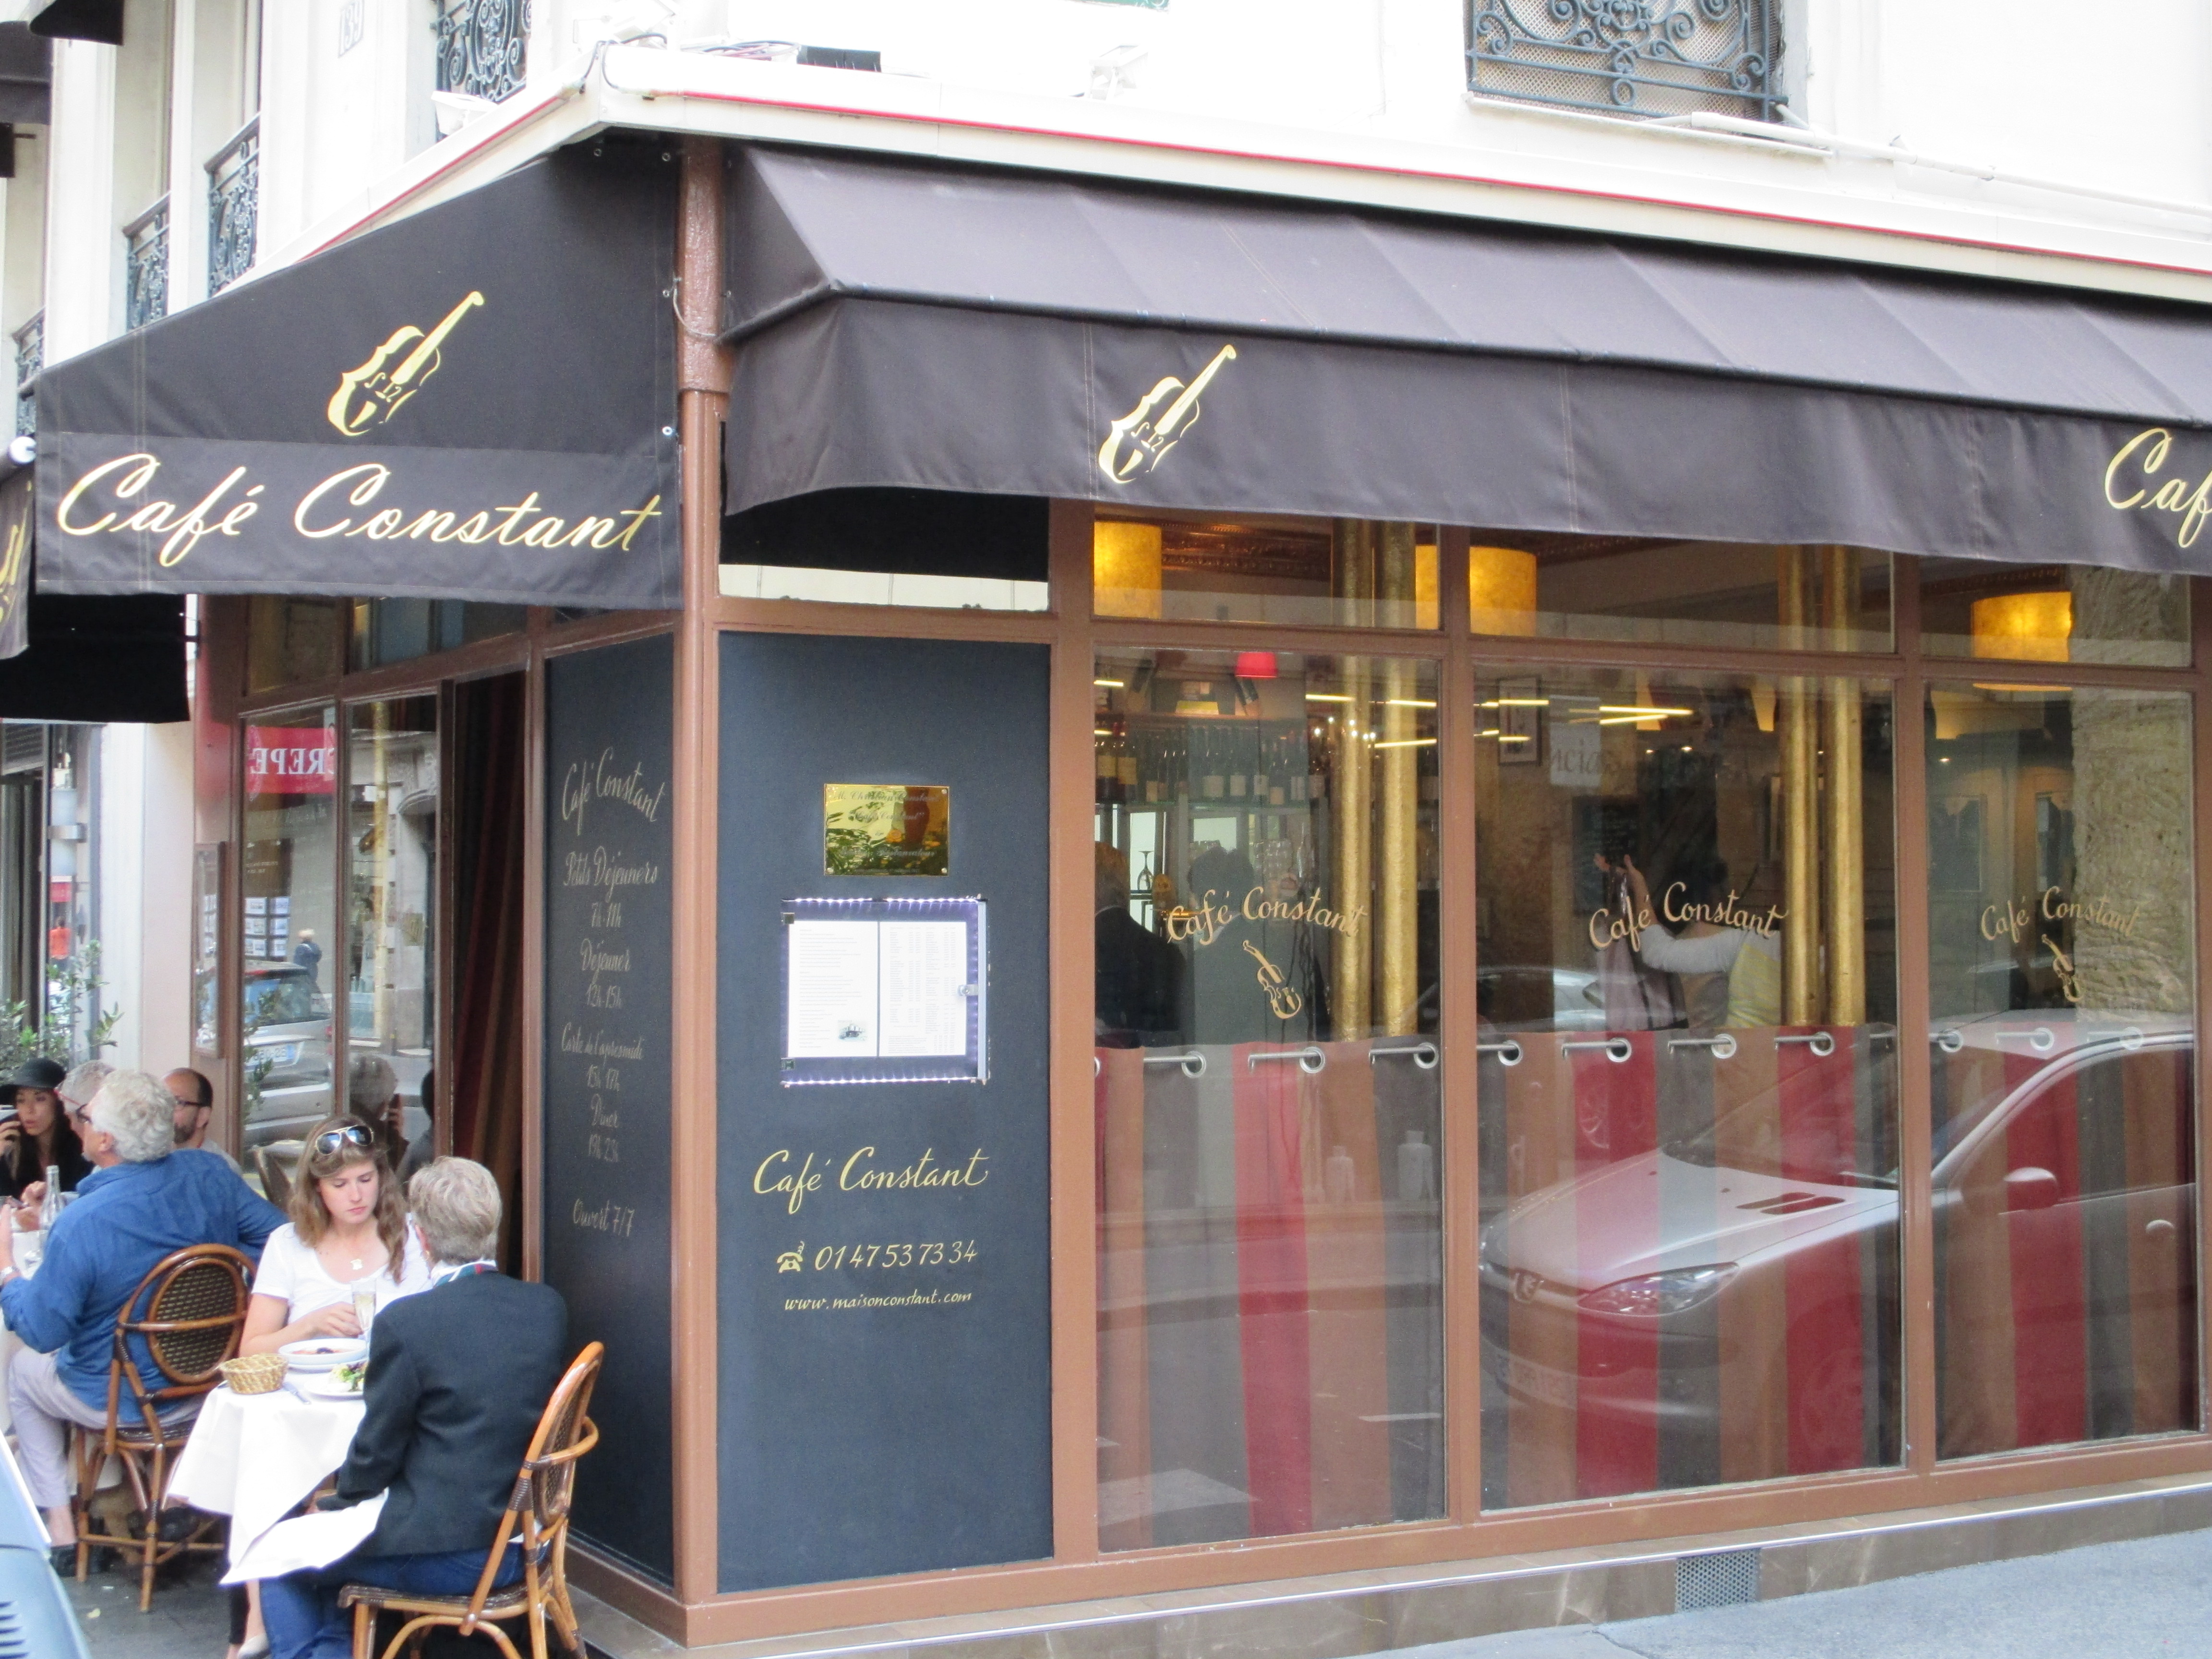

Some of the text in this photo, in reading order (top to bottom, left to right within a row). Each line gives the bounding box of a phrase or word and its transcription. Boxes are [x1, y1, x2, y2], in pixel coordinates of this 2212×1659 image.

[340, 1, 362, 54] 139
[58, 454, 661, 568] Café Constant
[562, 745, 666, 836] Café Constant
[563, 851, 591, 886] Petits
[1167, 887, 1367, 946] Café Constant
[1589, 882, 1789, 952] Café Constant
[1981, 886, 2145, 943] Café Constant
[753, 1146, 989, 1214] Café Constant
[573, 1199, 635, 1237] Ouvert 7/7
[785, 1288, 972, 1310] www.maisonconstant.com
